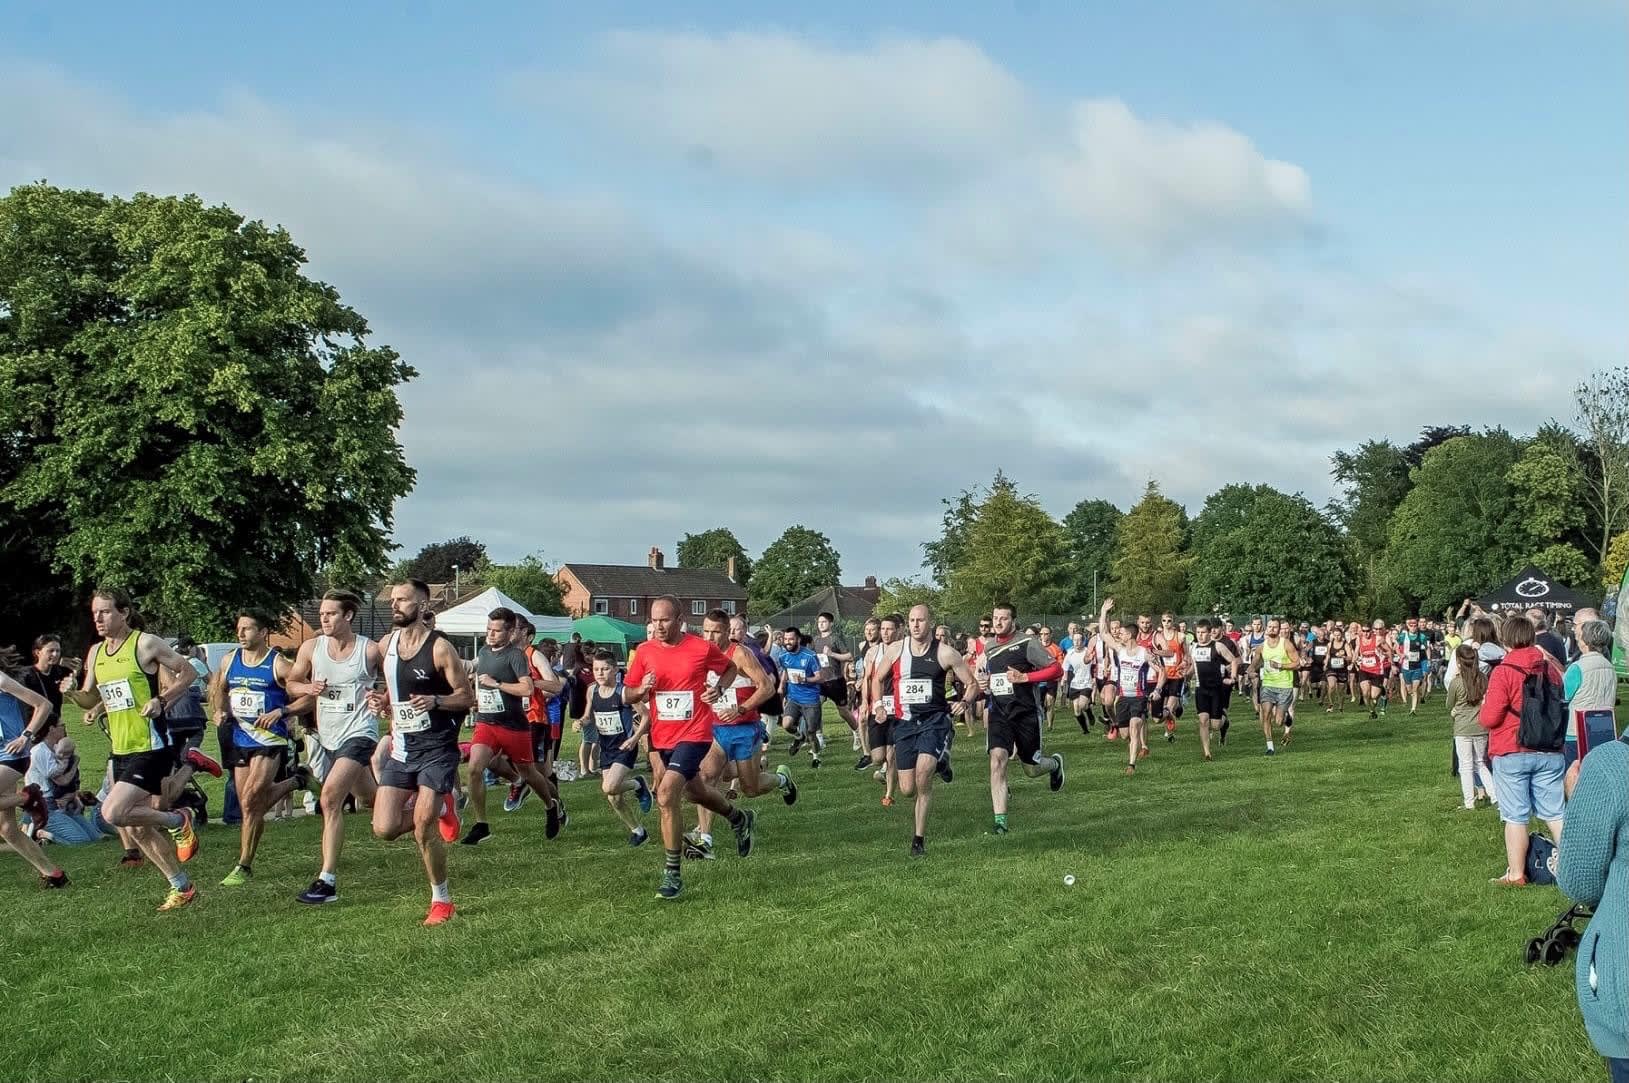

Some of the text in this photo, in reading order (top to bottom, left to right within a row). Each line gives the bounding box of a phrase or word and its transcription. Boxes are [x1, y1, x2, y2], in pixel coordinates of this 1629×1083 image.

[1500, 602, 1523, 610] TOTAL
[996, 678, 1004, 687] 20
[105, 687, 123, 700] 316
[905, 684, 924, 694] 284
[329, 690, 342, 700] 67
[240, 696, 252, 707] 80
[666, 698, 680, 709] 87
[598, 717, 613, 726] 317
